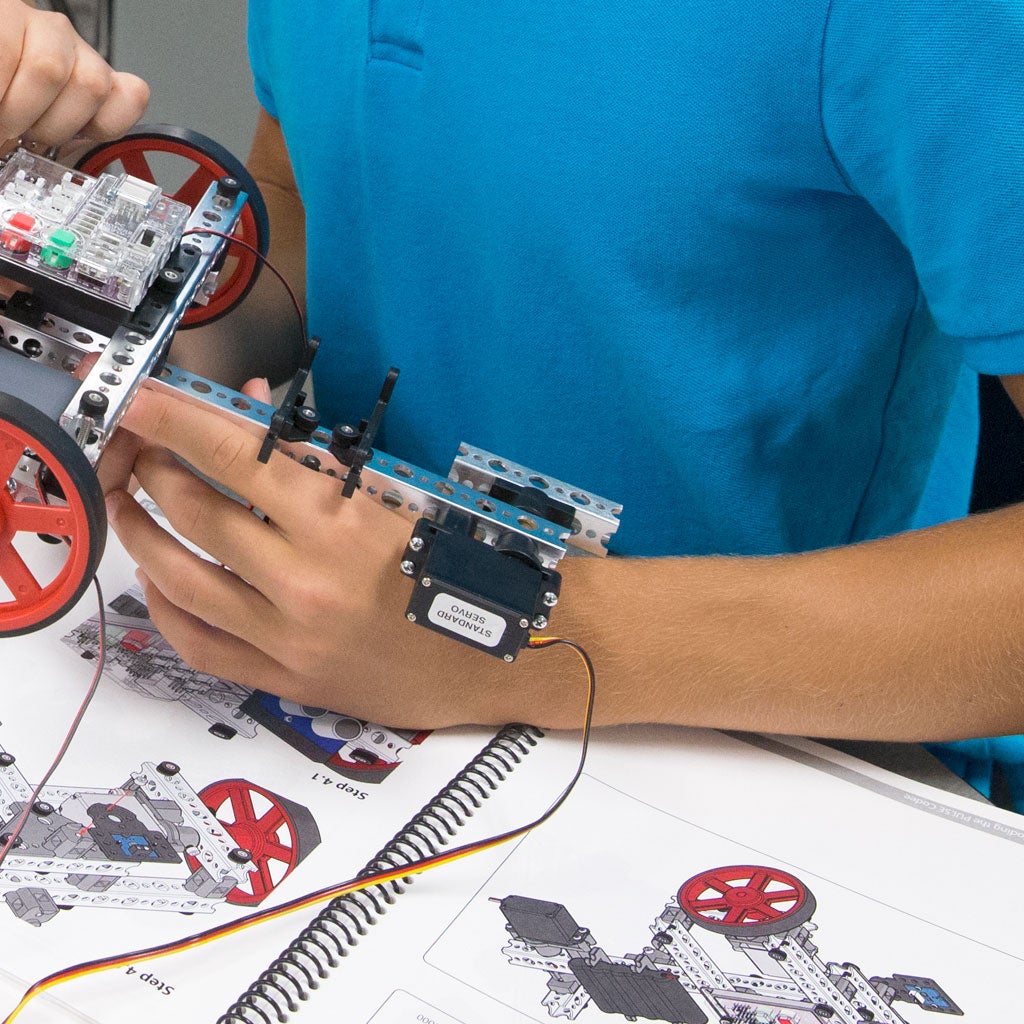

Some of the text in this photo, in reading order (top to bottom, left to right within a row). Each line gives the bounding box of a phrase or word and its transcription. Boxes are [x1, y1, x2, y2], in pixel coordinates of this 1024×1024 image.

[437, 610, 493, 638] STANDARD
[451, 605, 486, 624] SERVO
[311, 773, 369, 801] Step 4.1
[936, 805, 972, 823] PULSE
[973, 817, 991, 829] the
[993, 823, 1024, 840] oding
[139, 973, 175, 996] Step
